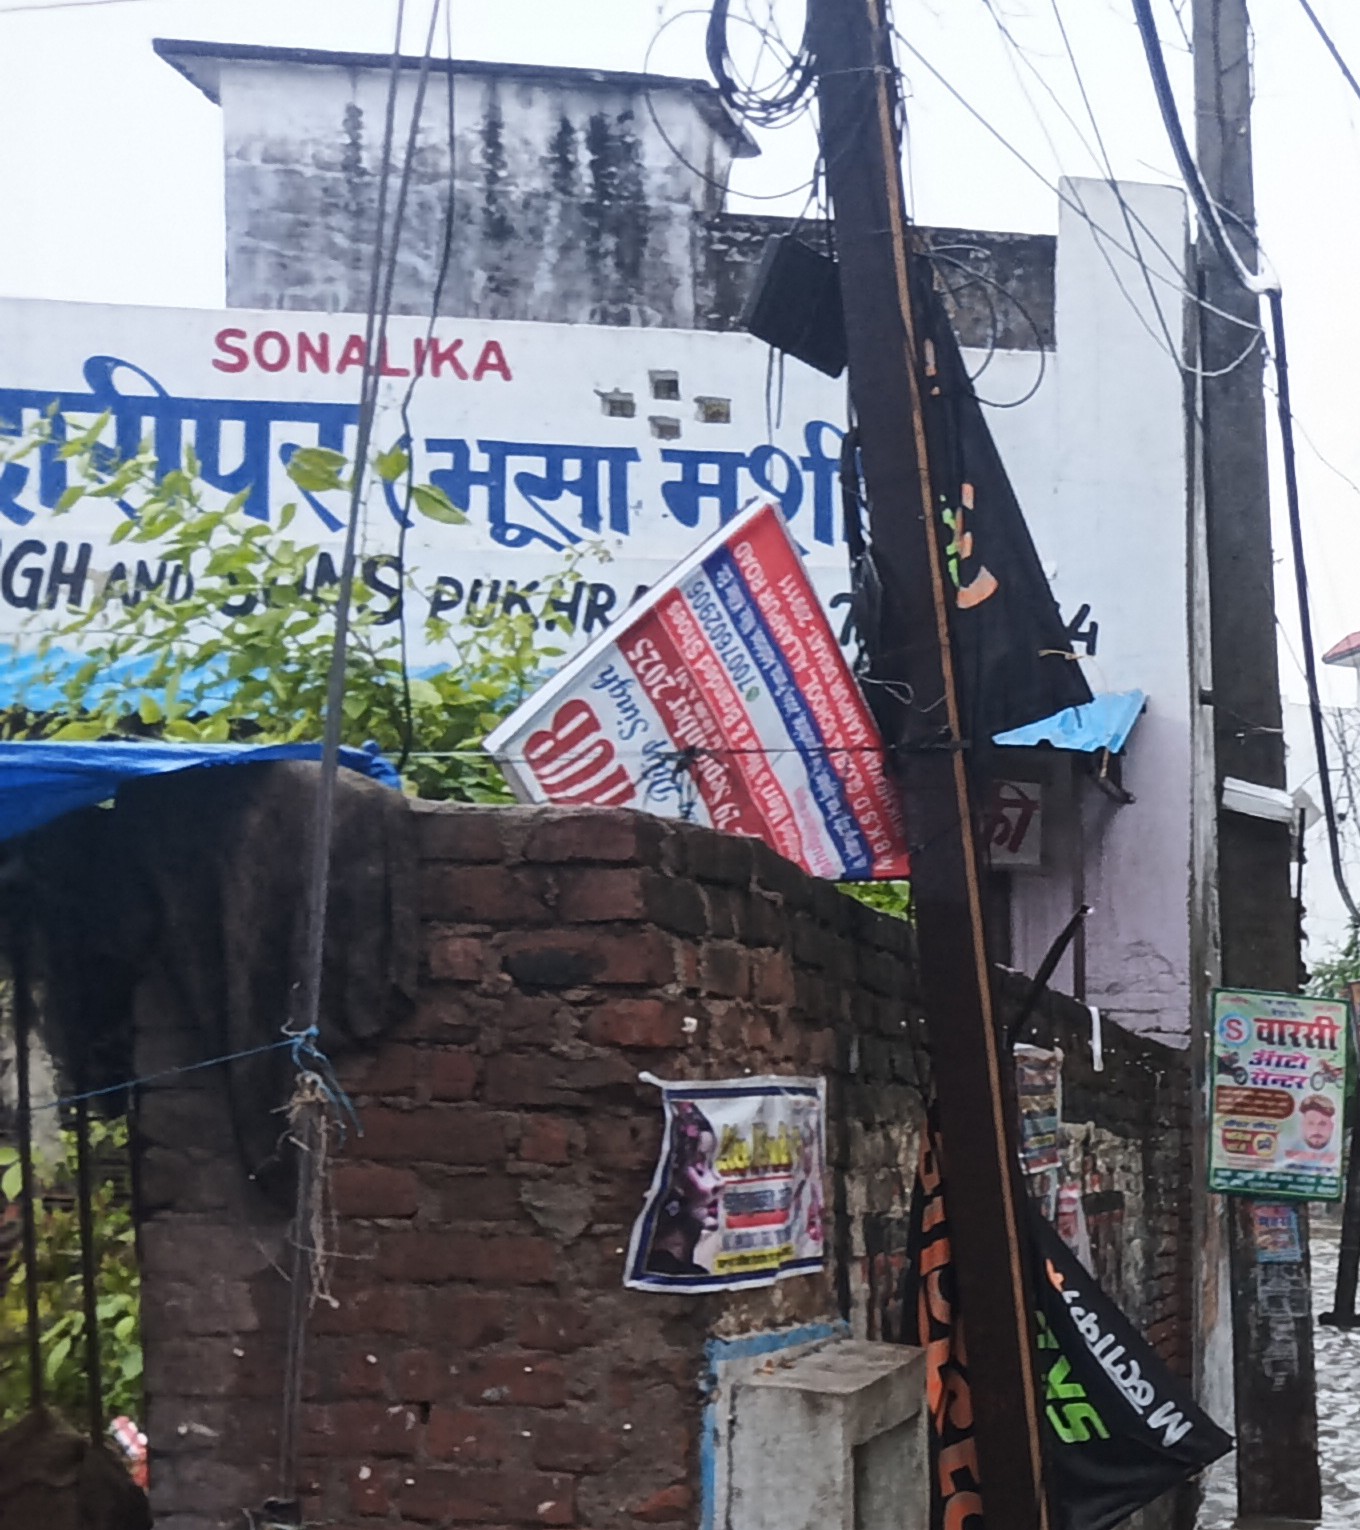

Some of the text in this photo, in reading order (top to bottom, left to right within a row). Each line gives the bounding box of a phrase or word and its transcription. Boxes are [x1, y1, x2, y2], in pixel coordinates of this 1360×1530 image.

[212, 328, 515, 382] SONALIKA
[659, 420, 850, 556] मशी
[0, 538, 93, 613] GH
[425, 574, 651, 635] PUKHR
[733, 539, 770, 594] ROAD
[664, 598, 706, 662] Shoes
[685, 579, 758, 694] 7007602906
[589, 664, 652, 743] Singh
[627, 635, 679, 703] 2025
[693, 652, 744, 729] Branded
[827, 676, 869, 746] KANPUR
